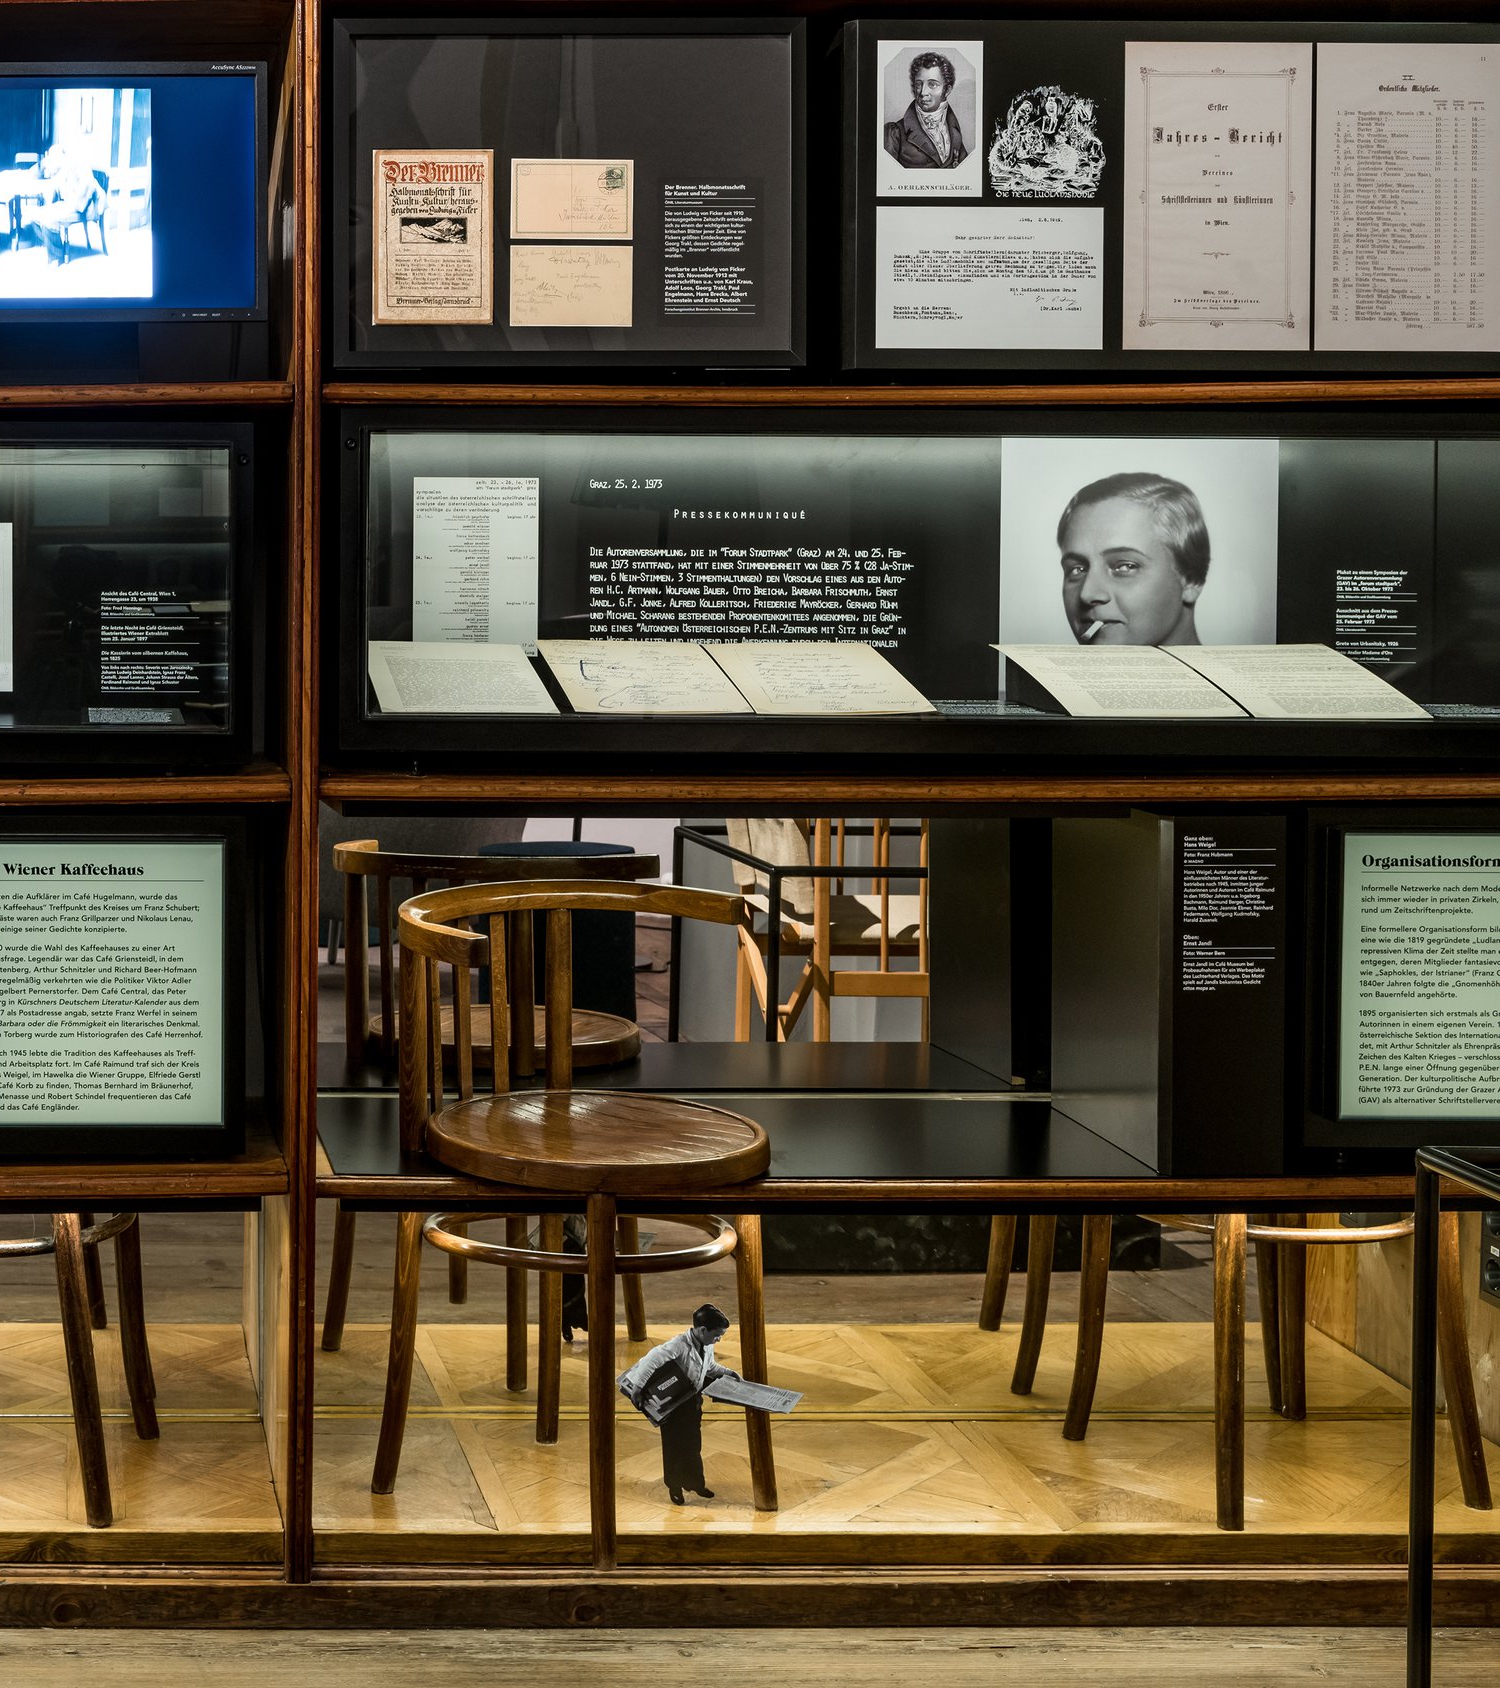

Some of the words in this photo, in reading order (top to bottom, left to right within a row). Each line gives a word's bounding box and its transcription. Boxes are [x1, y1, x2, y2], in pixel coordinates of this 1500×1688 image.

[382, 160, 418, 186] Der
[416, 160, 485, 184] Brenner
[3, 863, 56, 875] Wiener
[61, 863, 144, 875] Kaffeehaus
[1361, 884, 1398, 892] Informelle
[93, 893, 137, 902] Hugelmann,
[1361, 906, 1378, 914] rund
[1394, 906, 1473, 914] Zeitschriftenprojekte.
